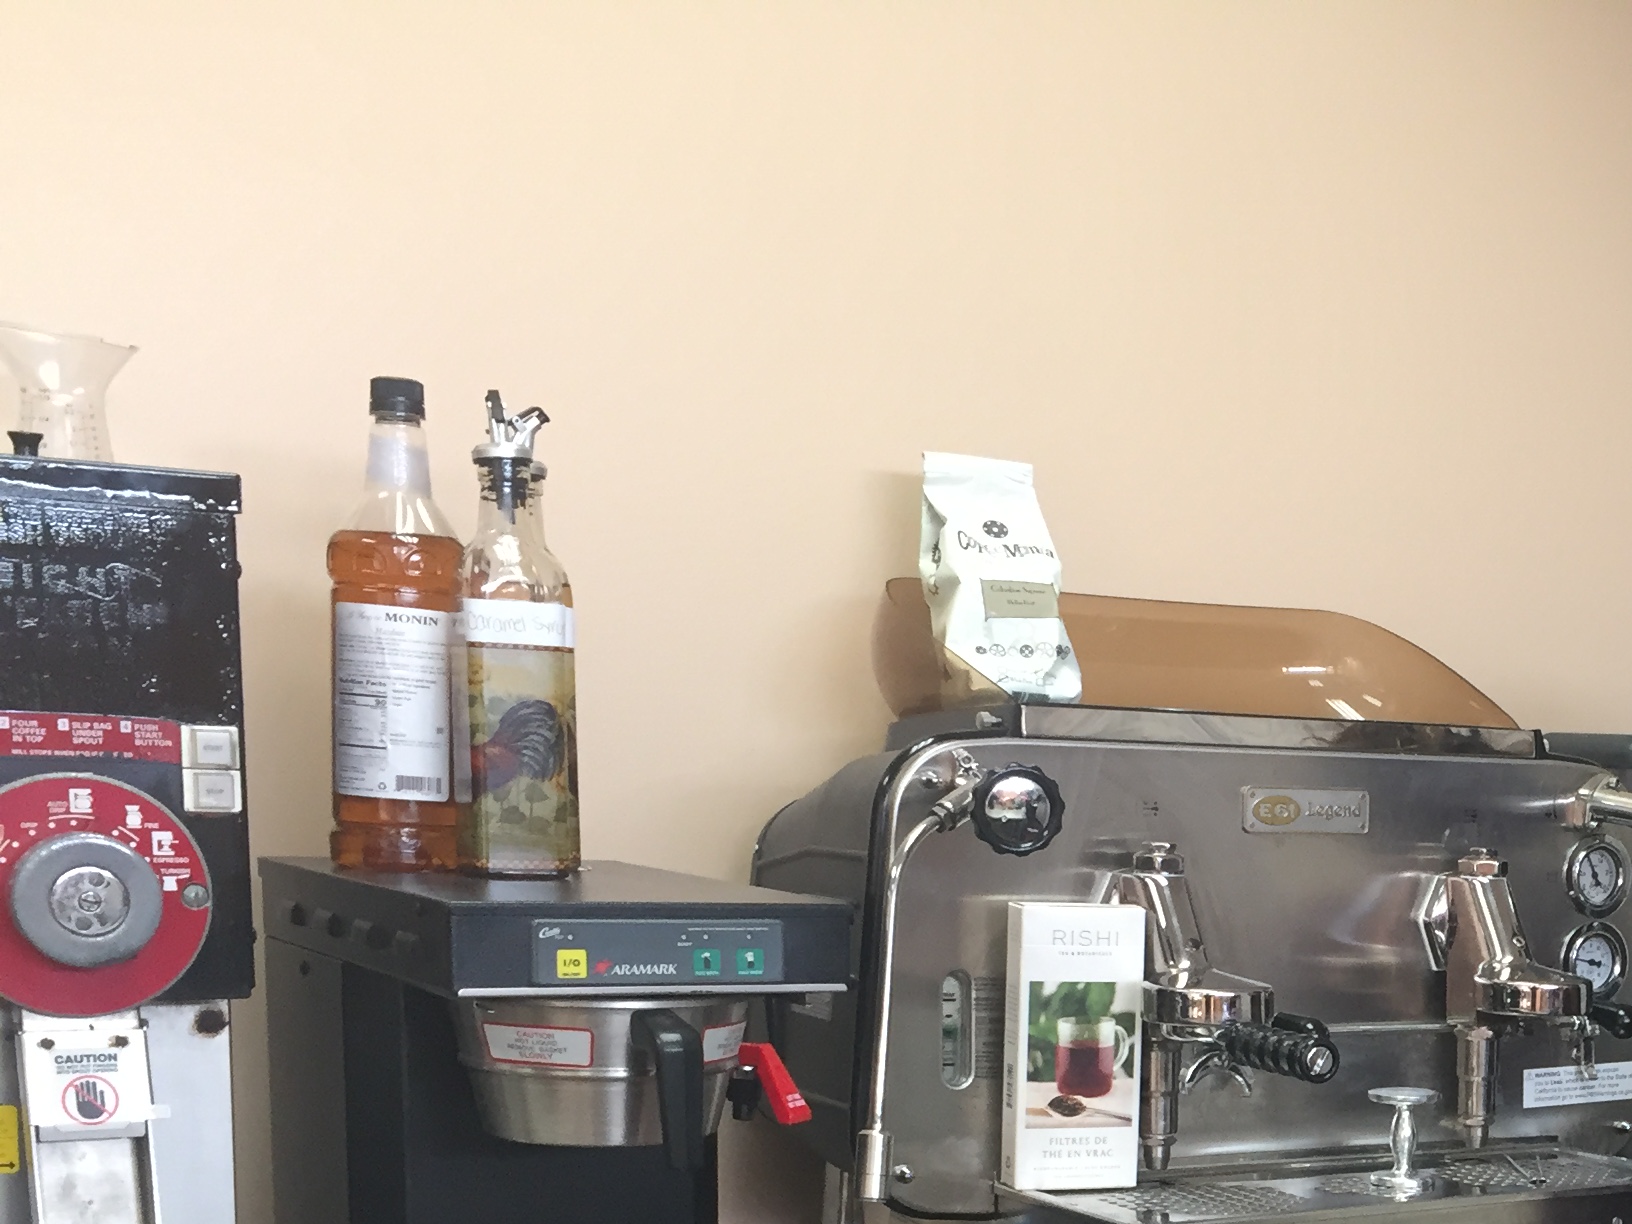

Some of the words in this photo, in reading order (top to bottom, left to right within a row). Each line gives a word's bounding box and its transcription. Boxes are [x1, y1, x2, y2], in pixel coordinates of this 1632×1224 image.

[958, 530, 1000, 555] Coff
[384, 612, 439, 627] MONIN
[467, 611, 526, 633] Caramel
[71, 721, 91, 729] SLIP
[93, 722, 112, 730] BAG
[11, 728, 48, 736] COFFEE
[72, 737, 104, 745] SPOUT
[134, 739, 173, 747] BUTTON
[1305, 802, 1362, 821] Legend
[1052, 929, 1119, 946] RISHI
[563, 959, 581, 968] I/O
[611, 963, 678, 975] ARAMARK
[517, 1030, 555, 1040] CAUTION
[54, 1052, 118, 1065] CAUTION
[1049, 1137, 1091, 1146] FILTRES
[1094, 1136, 1109, 1145] DE
[1067, 1150, 1081, 1158] EN
[1085, 1148, 1114, 1158] VRAC
